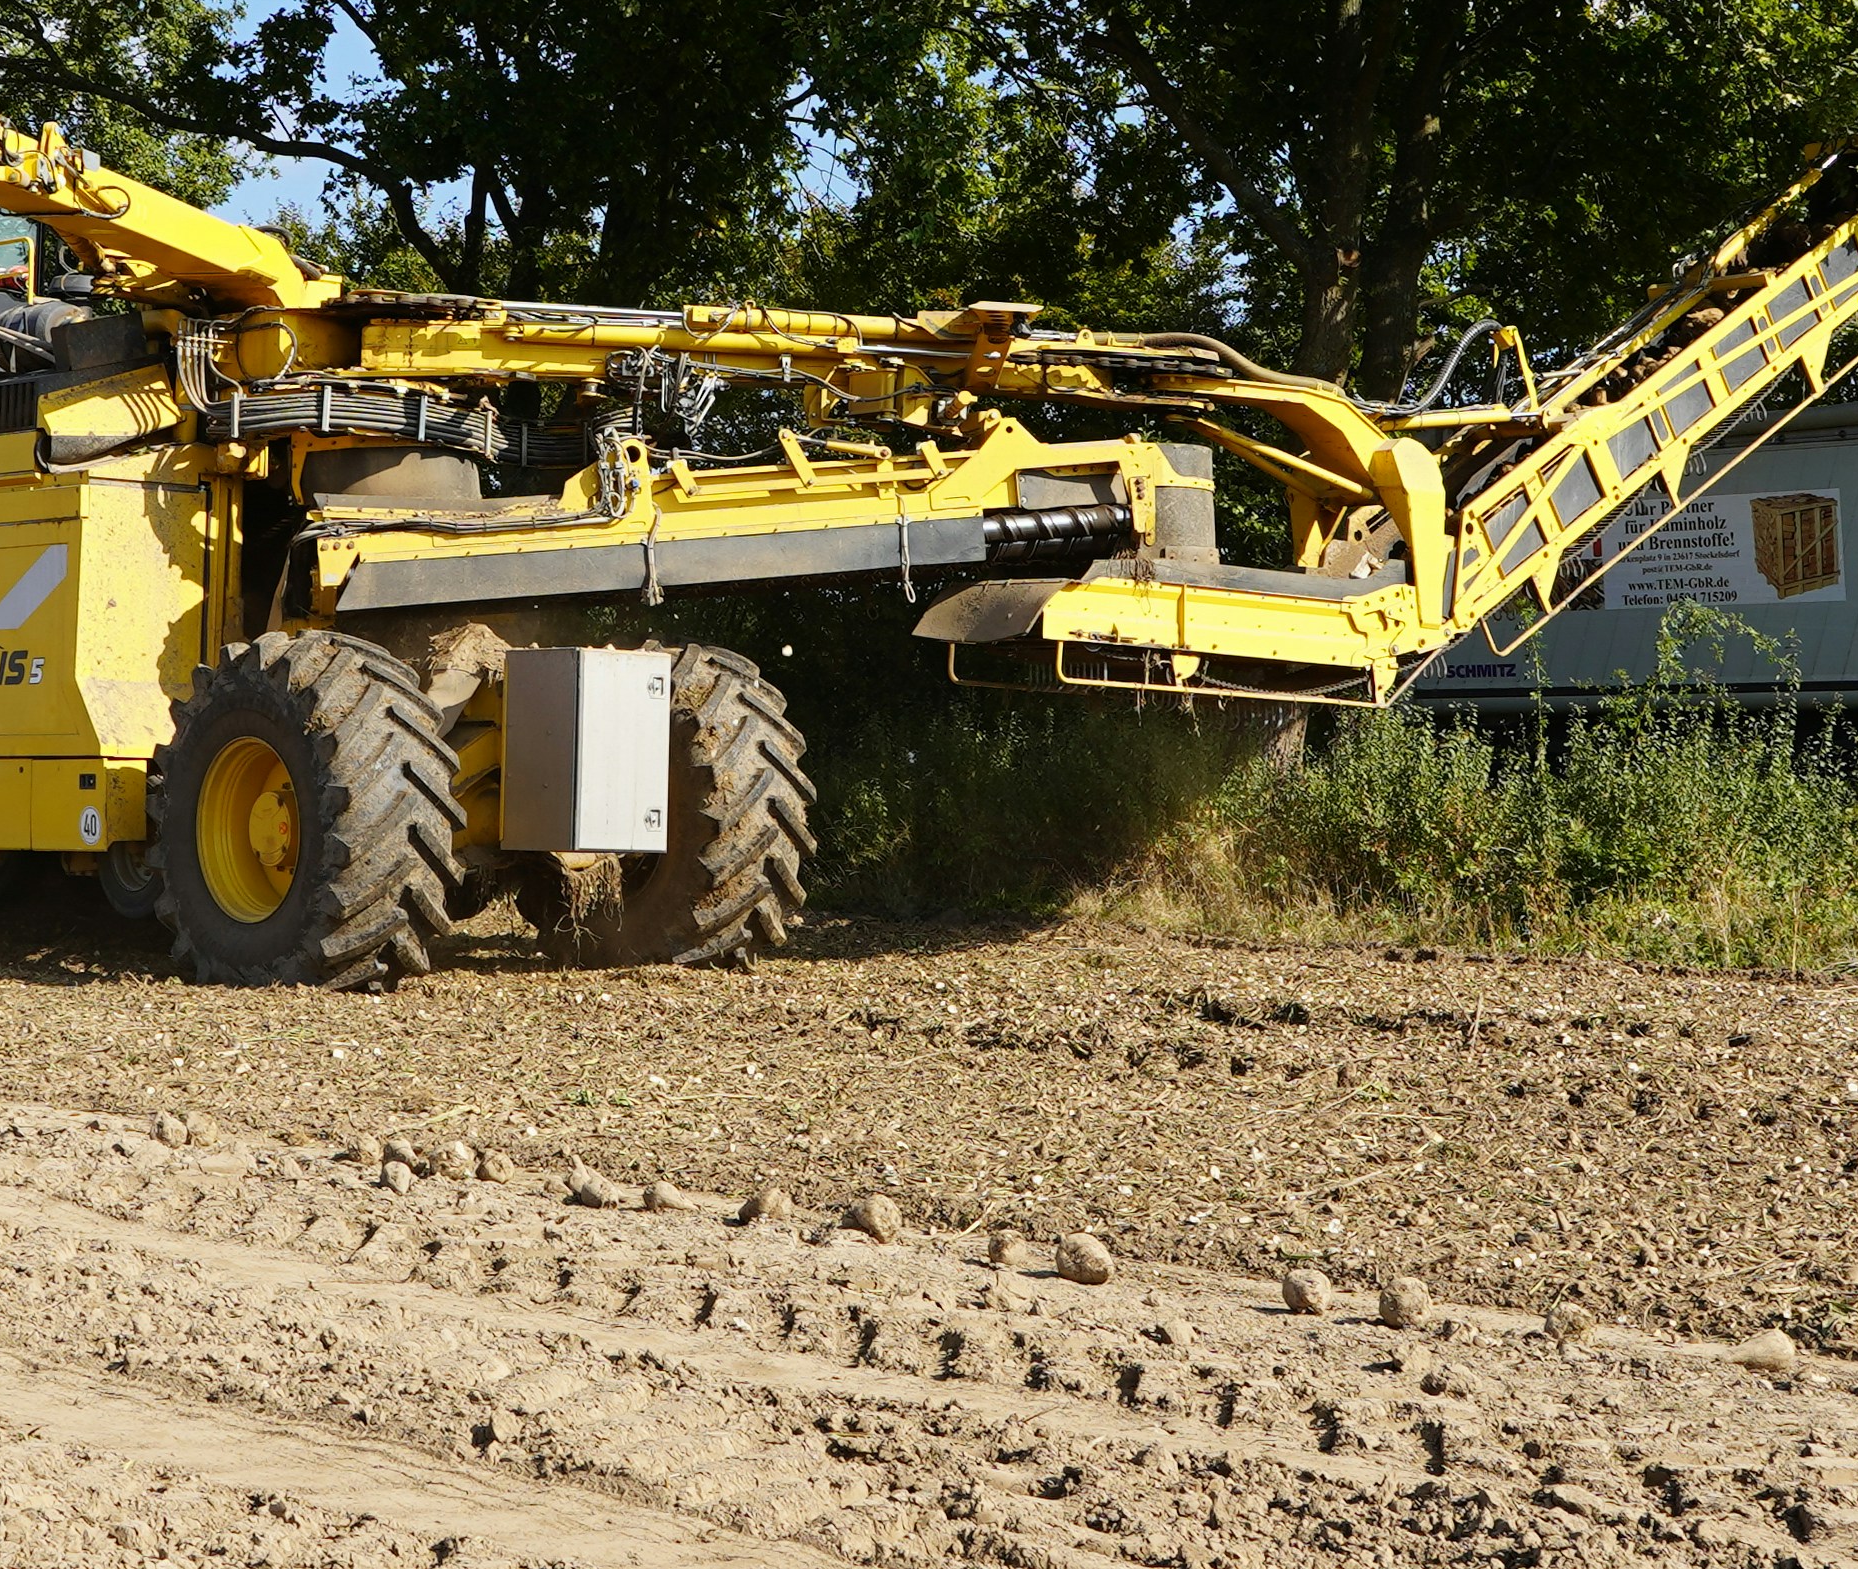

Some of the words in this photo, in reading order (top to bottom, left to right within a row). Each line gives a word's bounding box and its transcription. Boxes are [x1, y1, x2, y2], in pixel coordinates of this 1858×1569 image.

[1660, 501, 1715, 515] Ptner
[1625, 520, 1646, 535] für
[1618, 538, 1645, 552] ud
[1649, 531, 1735, 551] Brennstoffe!
[1664, 553, 1671, 561] in
[1672, 551, 1694, 560] 23617
[1694, 550, 1741, 559] Stockelsdorf
[1628, 576, 1730, 591] www.TEM-GbR.de
[1622, 594, 1664, 606] Telefon:
[1701, 591, 1738, 603] 715209
[29, 657, 46, 685] 5
[1445, 663, 1517, 679] SCHMITZ
[84, 814, 97, 836] 40
